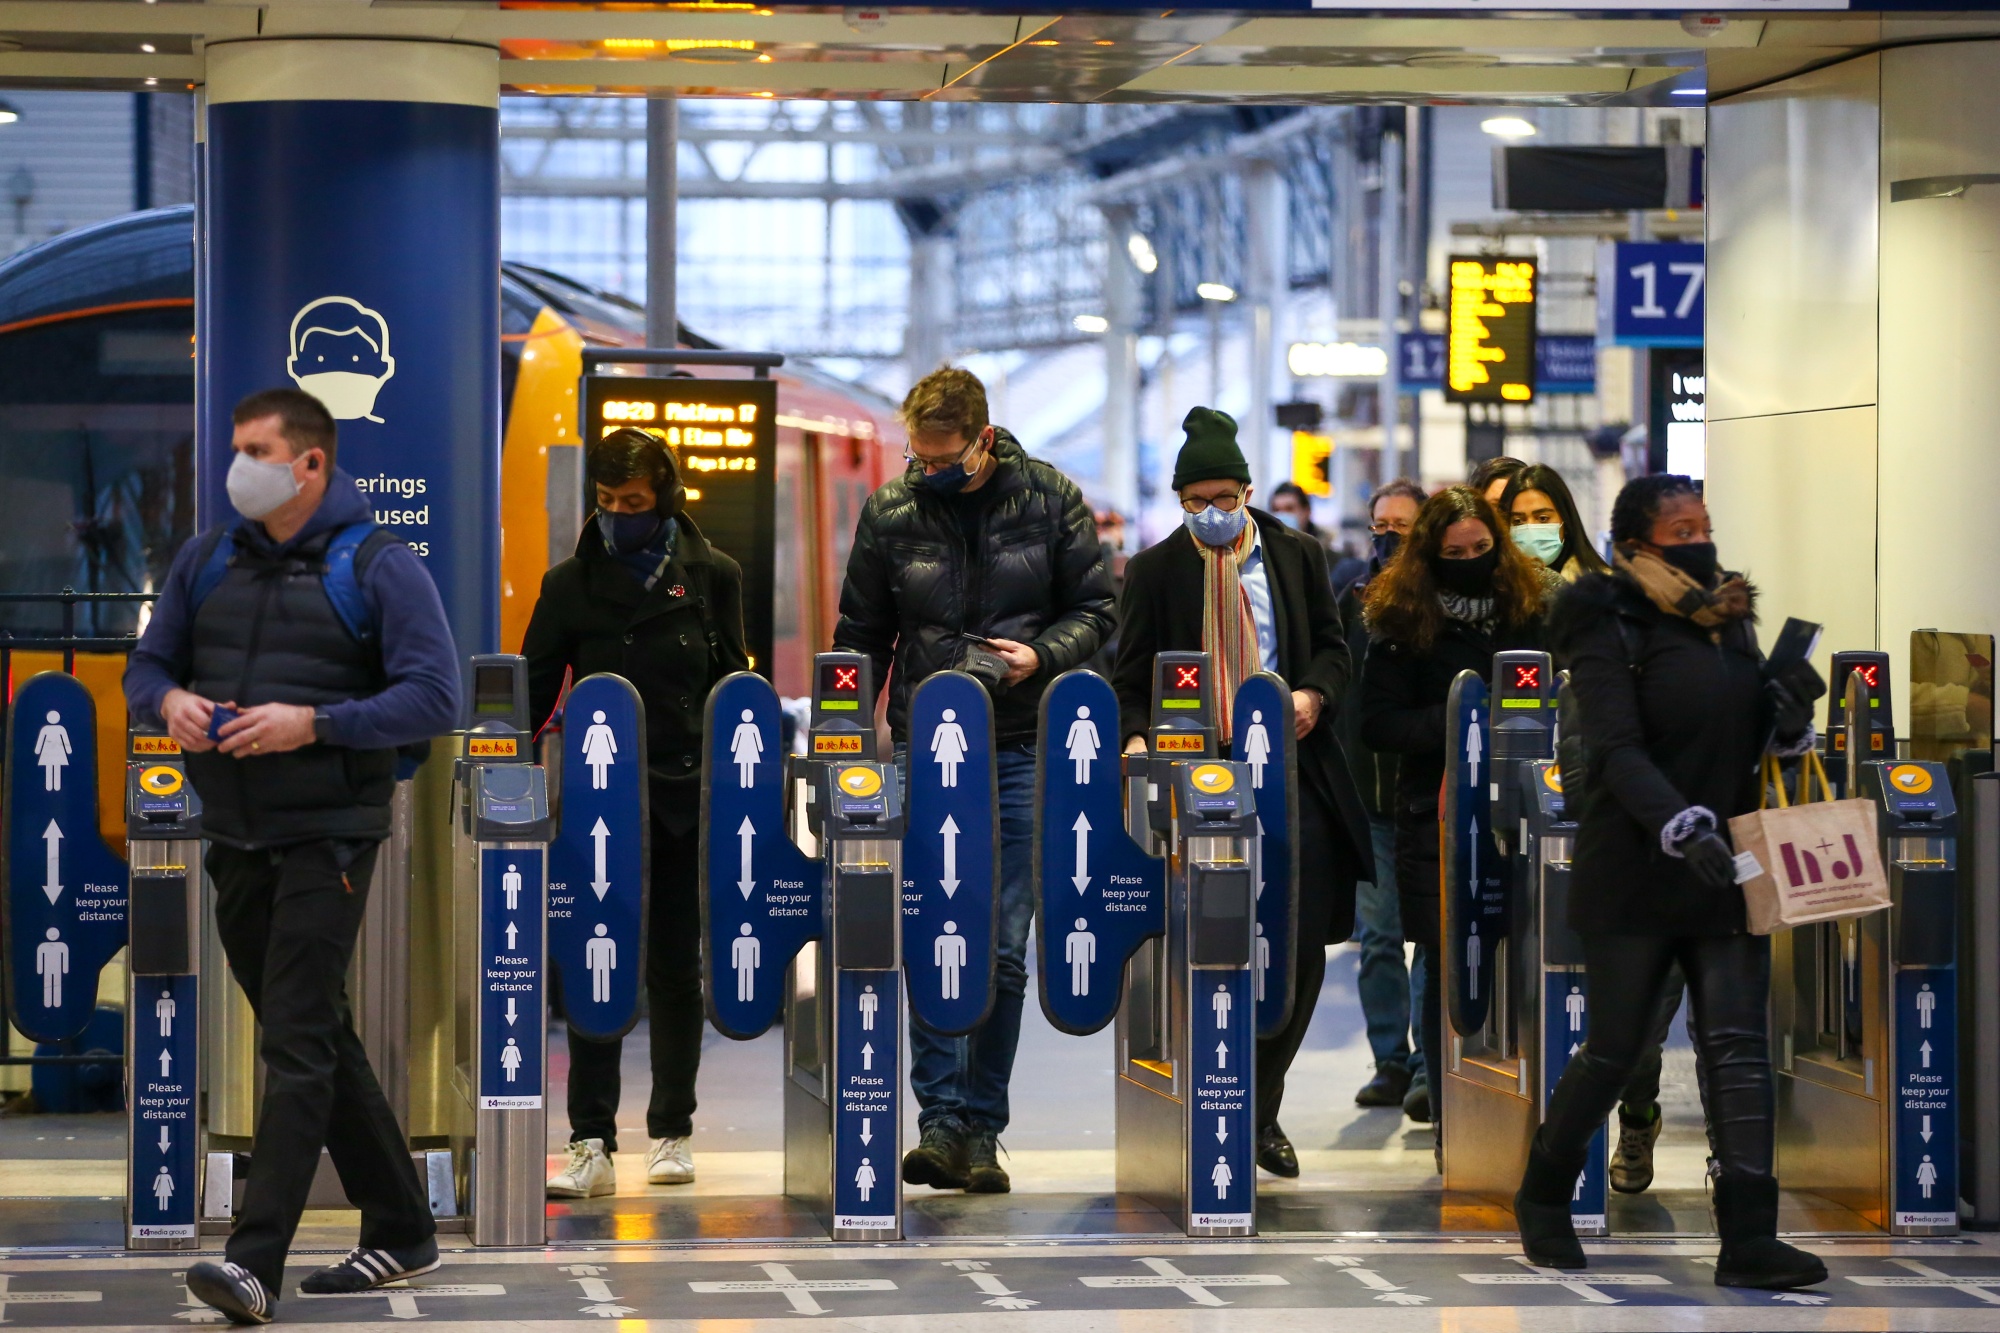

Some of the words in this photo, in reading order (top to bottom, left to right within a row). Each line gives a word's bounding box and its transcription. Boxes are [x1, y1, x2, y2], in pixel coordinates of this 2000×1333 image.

[1630, 262, 1704, 319] 17
[665, 402, 735, 422] Platform
[738, 404, 757, 423] 17
[687, 455, 718, 472] Page
[354, 472, 427, 498] erings
[375, 505, 429, 525] used
[773, 879, 804, 889] Please
[1110, 875, 1143, 884] Please
[84, 883, 119, 893] Please
[548, 882, 567, 890] ase
[766, 893, 788, 905] keep
[789, 894, 812, 905] your
[1102, 888, 1126, 900] keep
[1127, 890, 1151, 900] your
[75, 897, 101, 909] keep
[103, 898, 128, 909] your
[552, 896, 575, 906] your
[768, 907, 809, 917] distance
[1105, 902, 1147, 912] distance
[79, 911, 124, 921] distance
[548, 910, 572, 918] ance
[495, 955, 529, 965] Please
[487, 969, 511, 980] keep
[513, 970, 537, 980] your
[490, 982, 533, 992] distance
[851, 1076, 884, 1085] Please
[1205, 1074, 1238, 1084] Please
[1909, 1073, 1942, 1083] Please
[148, 1083, 182, 1092] Please
[1901, 1086, 1926, 1098] keep
[1928, 1088, 1950, 1098] your
[842, 1089, 867, 1101] keep
[868, 1091, 891, 1101] your
[1197, 1087, 1222, 1099] keep
[1223, 1089, 1246, 1099] your
[140, 1096, 165, 1108] keep
[167, 1098, 190, 1108] your
[845, 1102, 888, 1112] distance
[1200, 1100, 1243, 1110] distance
[1904, 1100, 1947, 1109] distance
[143, 1110, 187, 1119] distance
